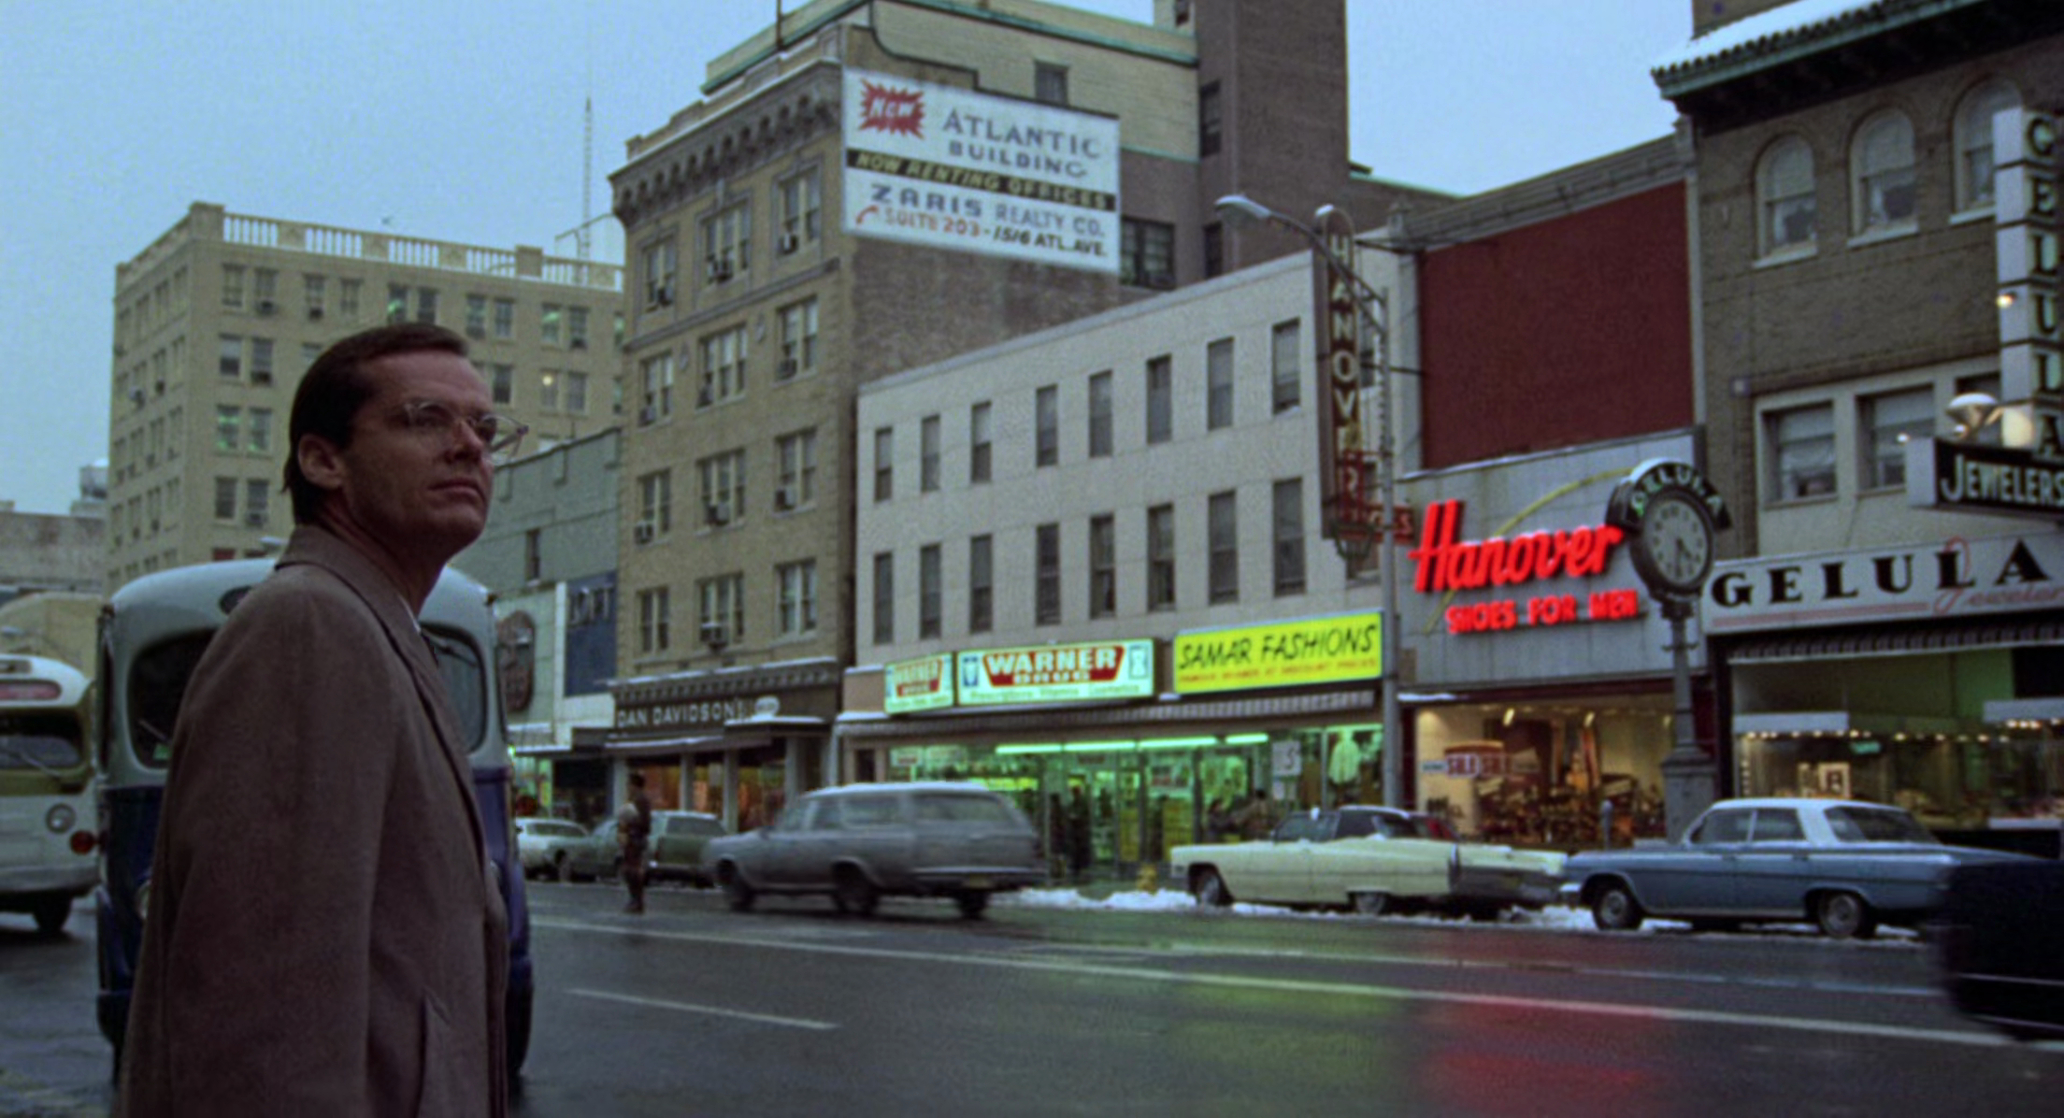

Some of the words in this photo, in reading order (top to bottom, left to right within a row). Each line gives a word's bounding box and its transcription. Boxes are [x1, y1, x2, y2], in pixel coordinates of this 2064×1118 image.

[943, 108, 1101, 160] ATLANTIC
[856, 150, 900, 173] NOW
[905, 161, 999, 190] RENTING
[1007, 177, 1107, 208] OFFICES
[948, 139, 1088, 178] BUILDING
[871, 183, 983, 217] ZARIS
[995, 203, 1066, 230] REALTY
[884, 206, 938, 231] SUITE
[1407, 498, 1625, 593] Hanover
[1710, 538, 2053, 608] GELULA
[1445, 599, 1518, 634] SHOES
[1527, 594, 1577, 626] FOR
[1588, 588, 1639, 619] MEN
[986, 647, 1118, 676] WARNER
[1179, 636, 1252, 670] SAMAR
[1261, 624, 1378, 662] FASHIONS
[617, 708, 647, 727] DAN
